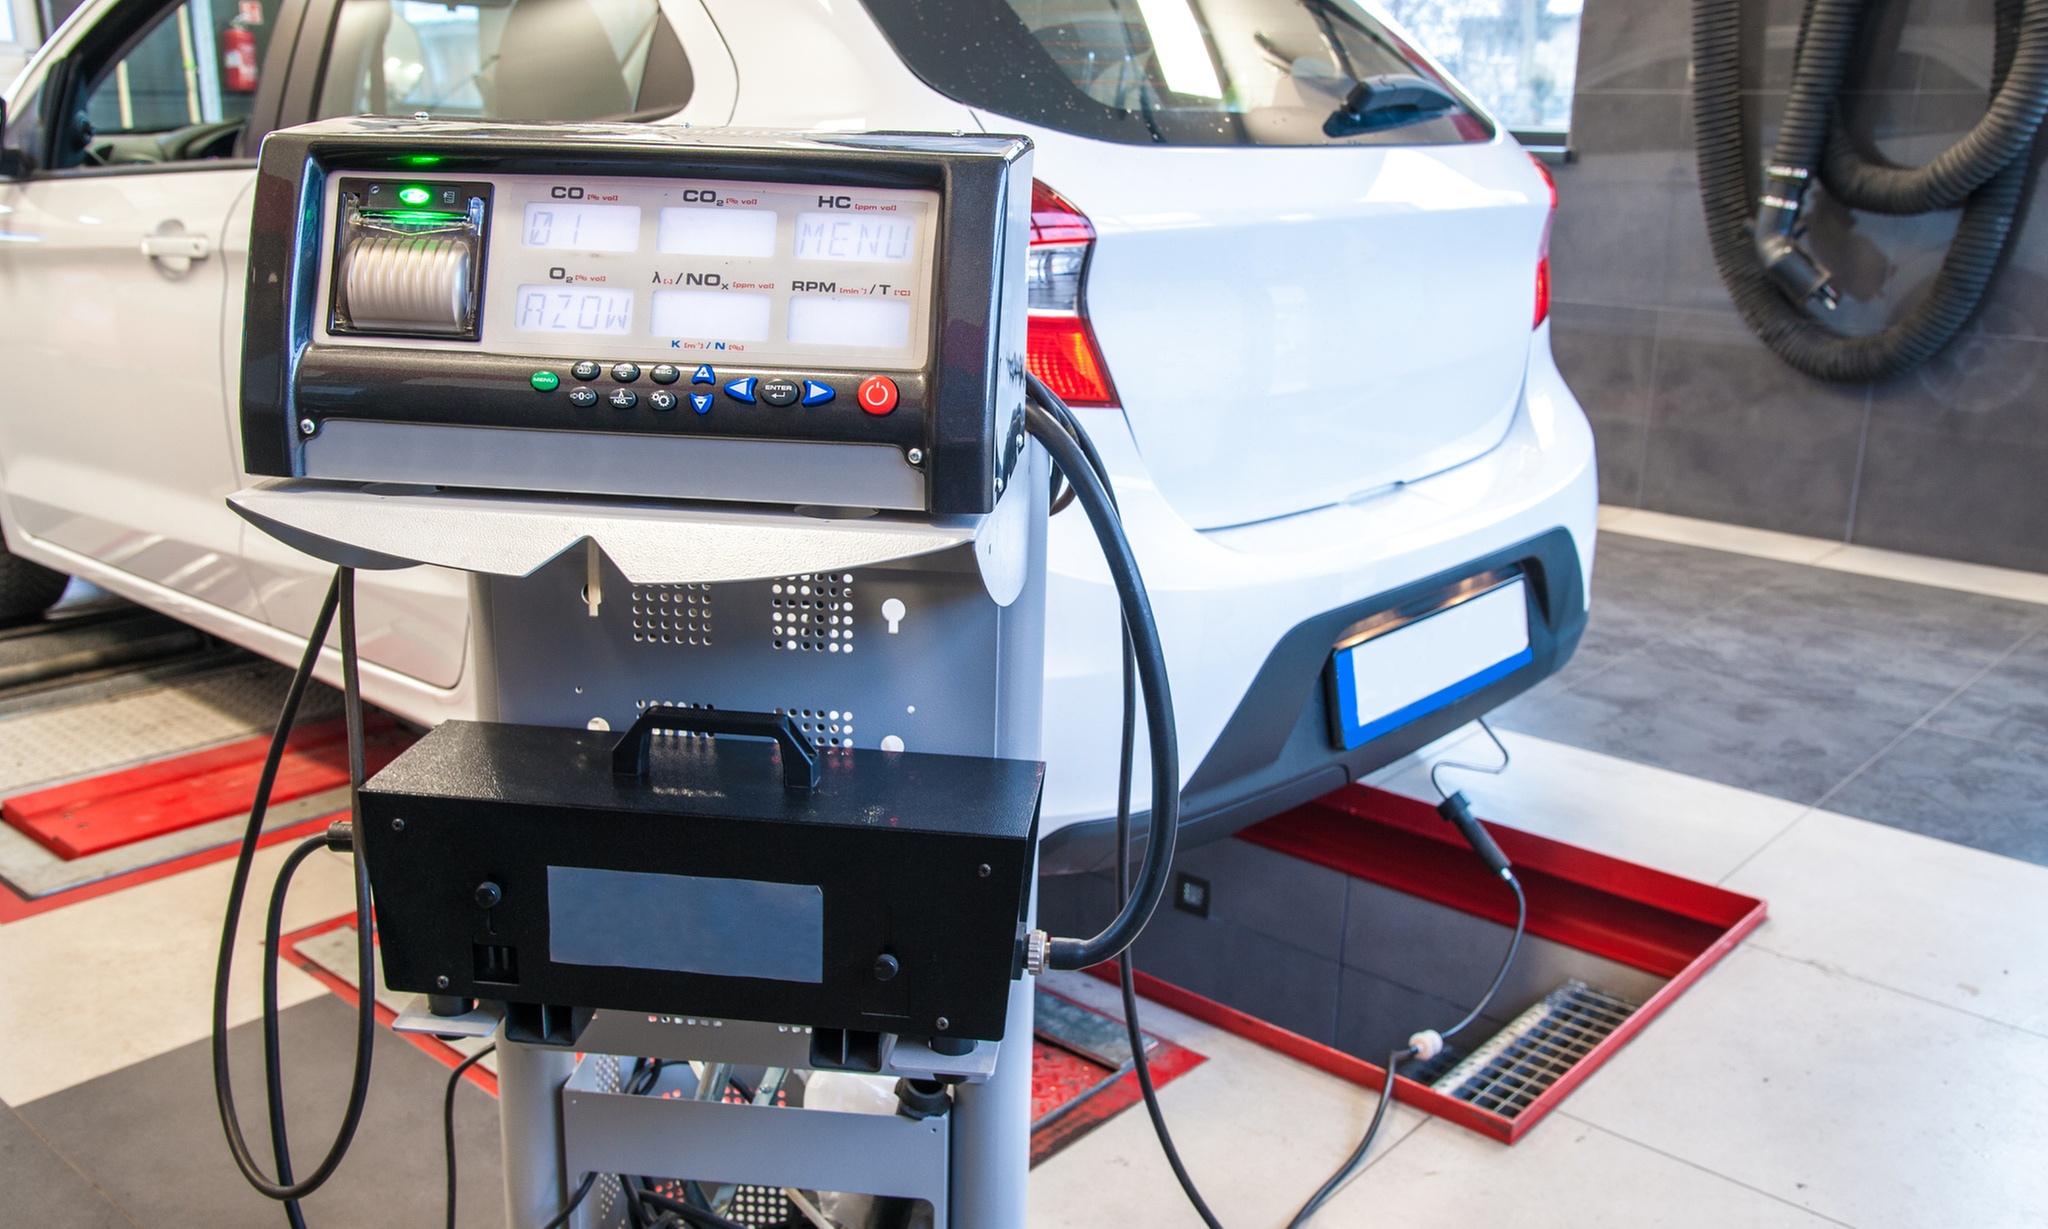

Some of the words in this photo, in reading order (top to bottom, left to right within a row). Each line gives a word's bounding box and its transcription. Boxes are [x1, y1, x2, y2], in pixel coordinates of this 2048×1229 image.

[551, 186, 584, 199] CO
[818, 195, 851, 209] HC
[799, 221, 911, 260] MENU
[792, 281, 836, 294] RPM
[879, 284, 891, 295] T
[671, 340, 680, 348] K
[715, 342, 725, 350] N
[532, 376, 555, 384] MENU
